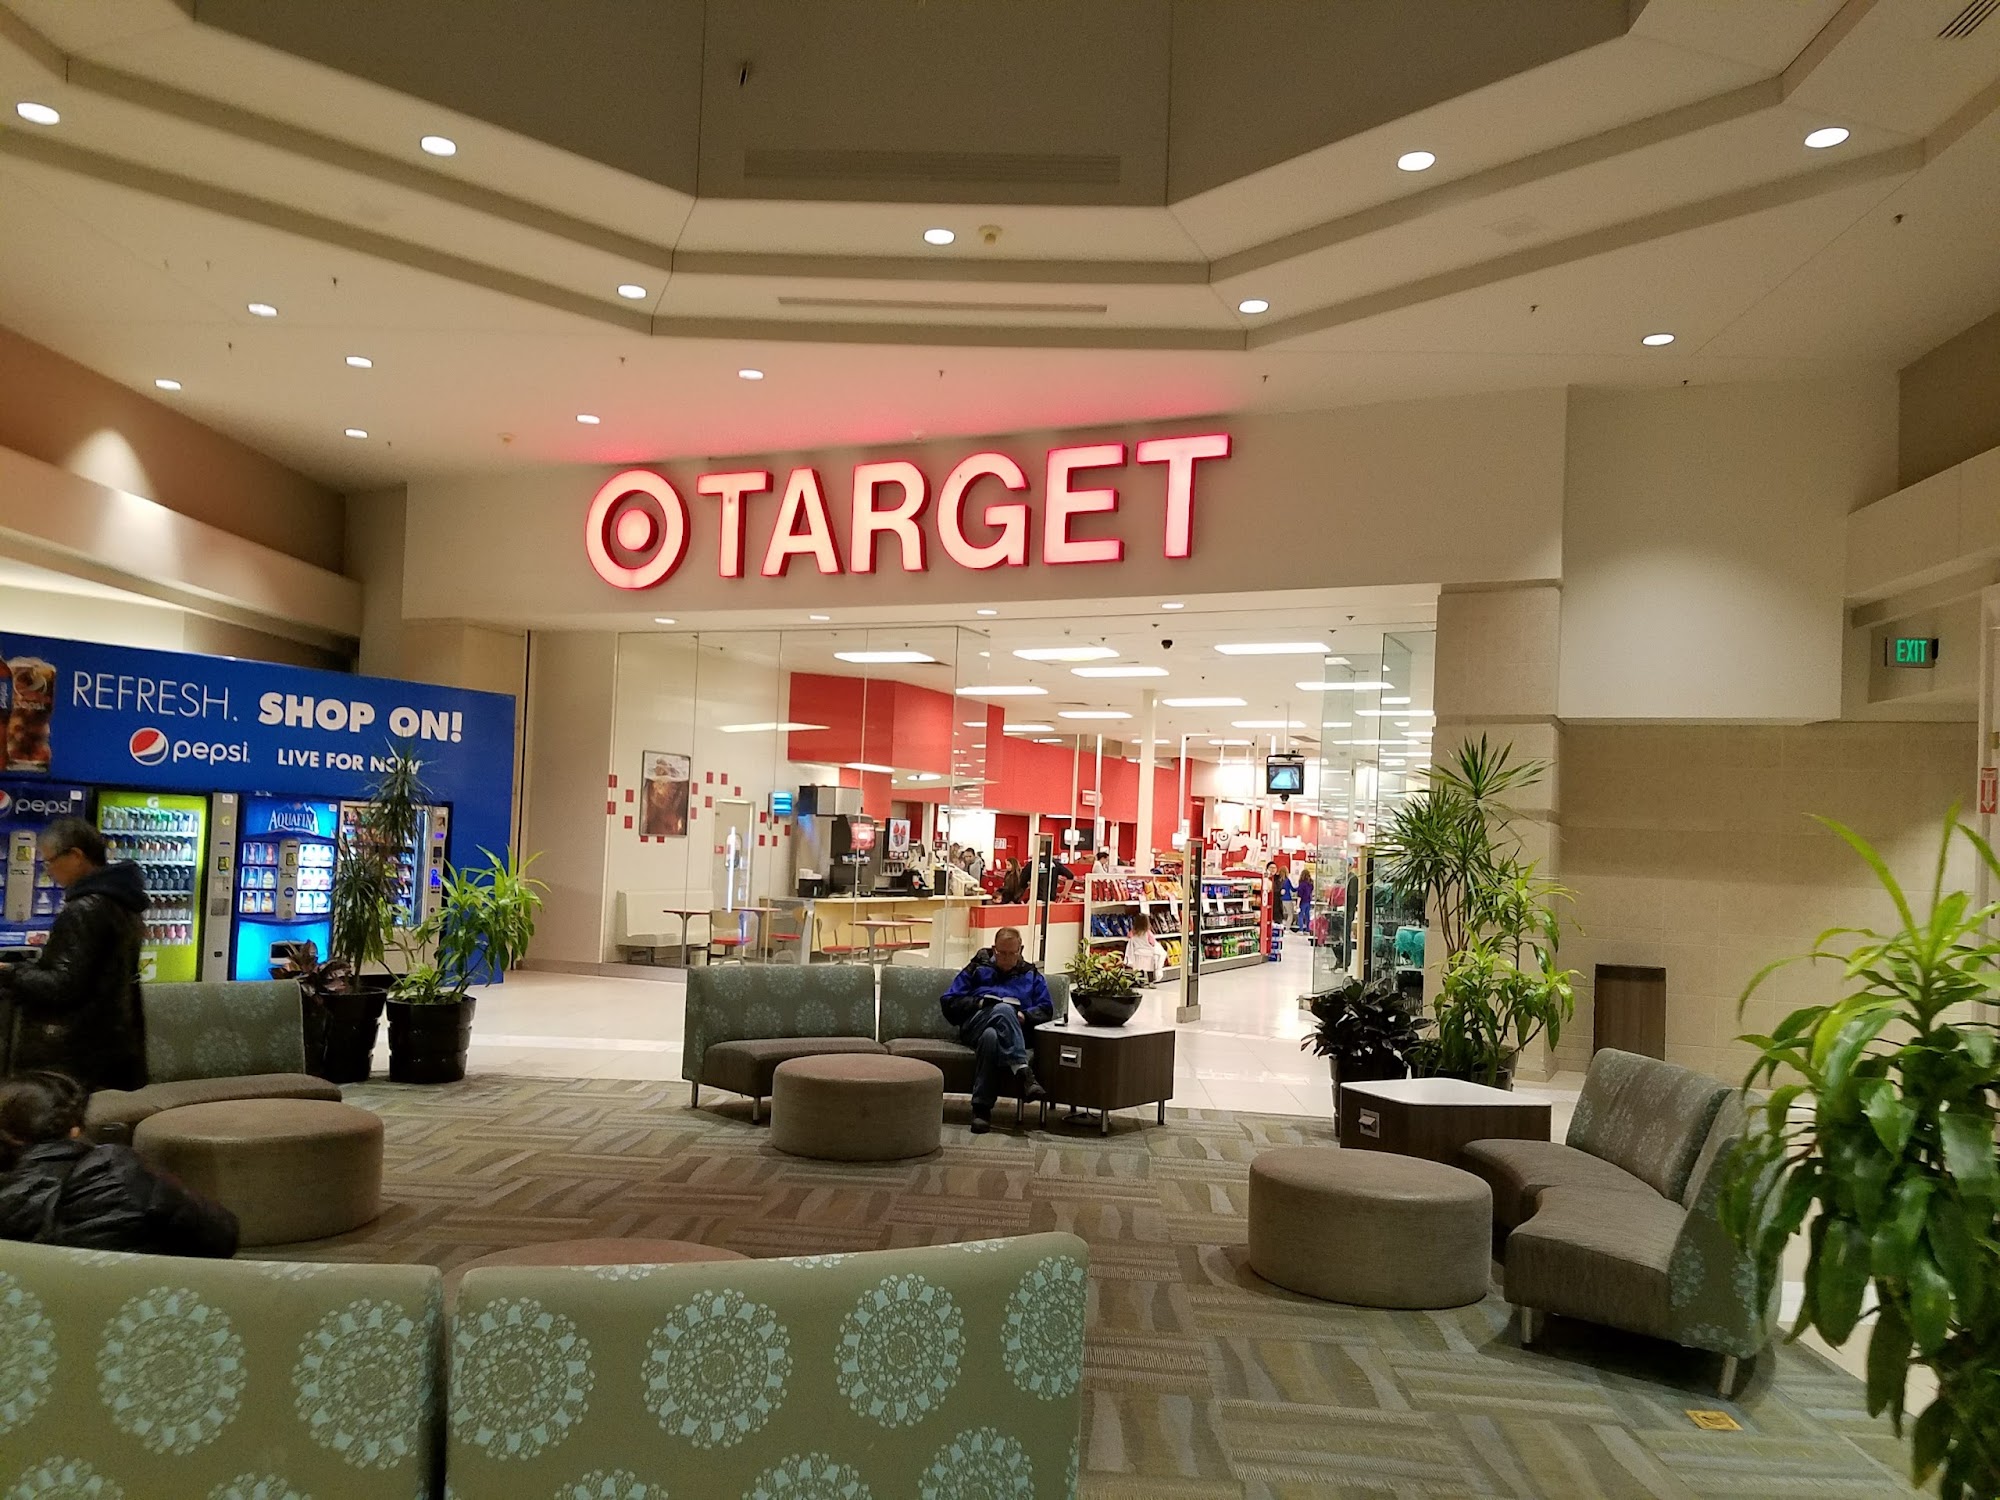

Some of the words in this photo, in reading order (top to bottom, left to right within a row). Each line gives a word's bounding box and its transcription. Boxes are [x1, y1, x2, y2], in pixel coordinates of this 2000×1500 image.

[697, 433, 1232, 578] TARGET
[1896, 639, 1927, 662] EXIT
[73, 671, 238, 722] REFRESH.
[258, 691, 376, 733] SHOP
[389, 707, 463, 743] ON!
[173, 741, 249, 765] pepsi
[278, 748, 320, 768] LIVE
[325, 752, 364, 772] FOR
[370, 755, 423, 775] NOW
[15, 800, 72, 816] pepsi
[268, 807, 319, 834] AQUAFINA
